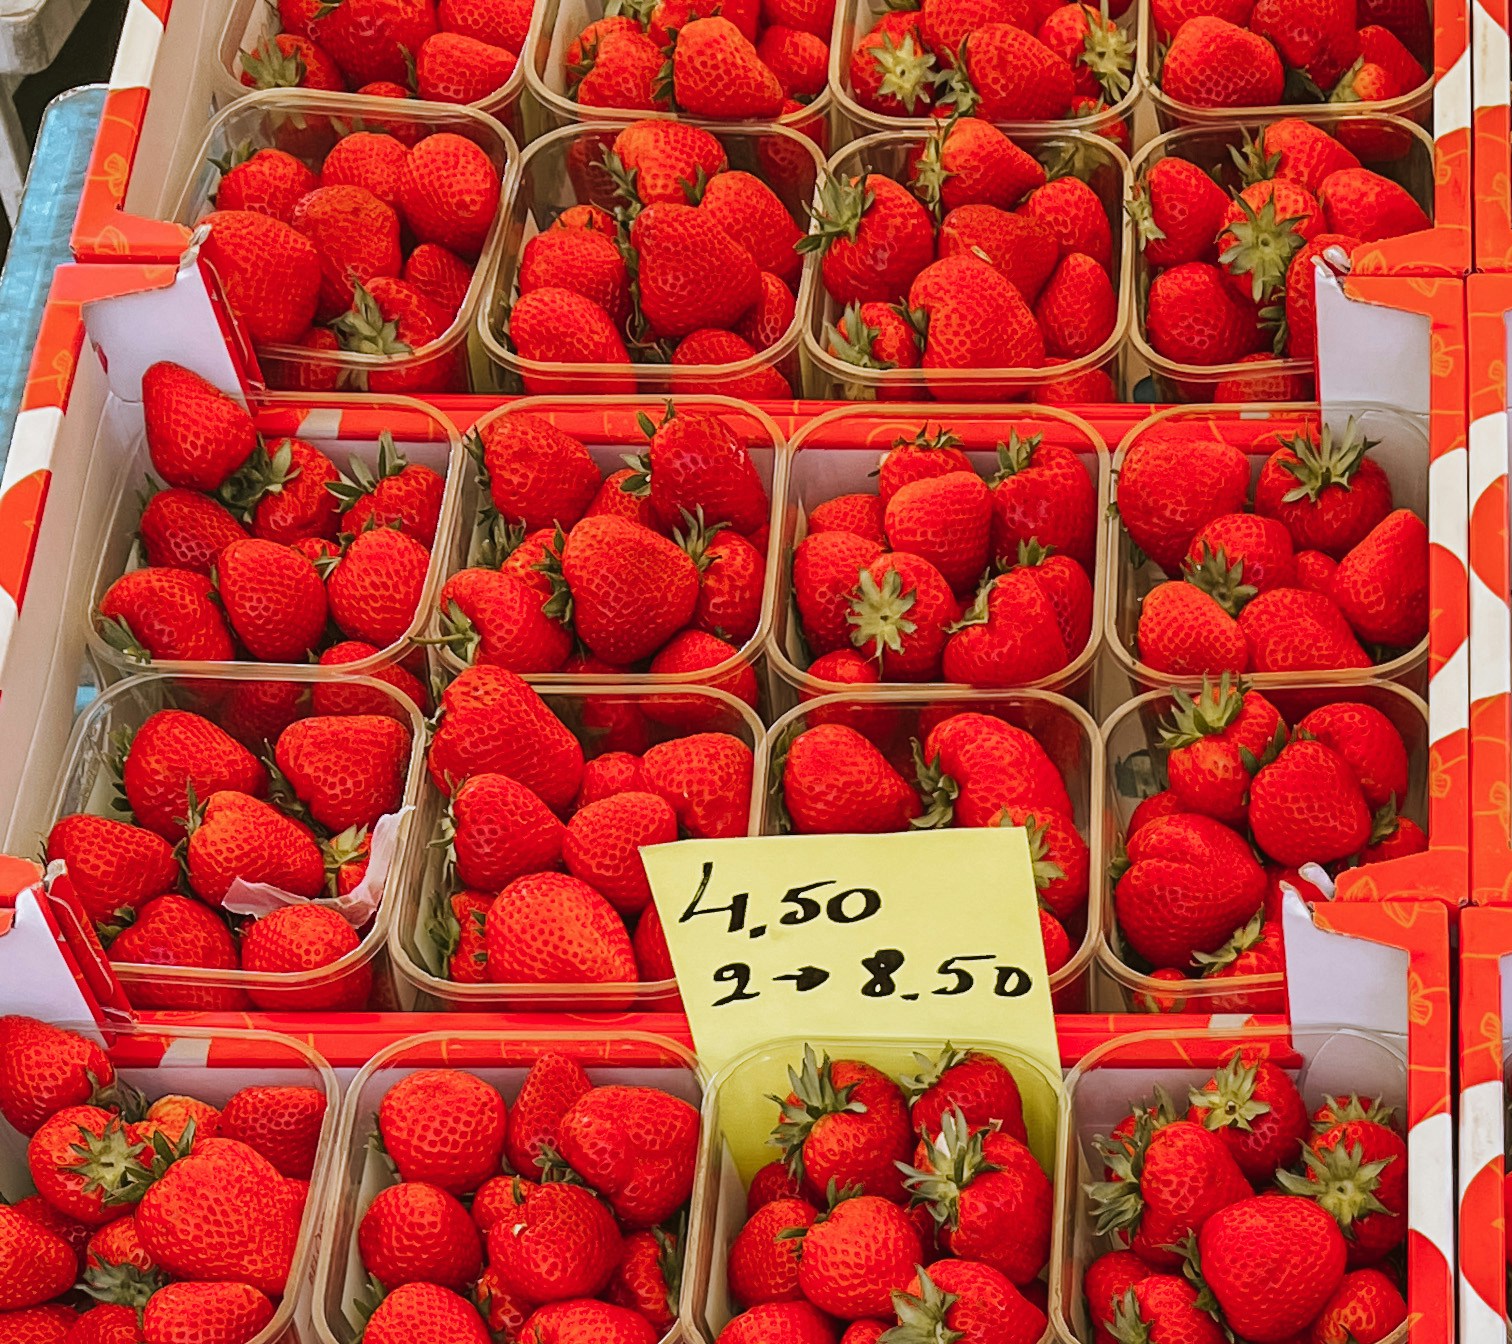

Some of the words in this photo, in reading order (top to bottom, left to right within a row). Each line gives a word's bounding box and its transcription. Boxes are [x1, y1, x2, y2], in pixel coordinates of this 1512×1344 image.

[678, 861, 882, 938] 4.50
[711, 962, 761, 1006] 2
[860, 948, 1033, 1001] 8.50
